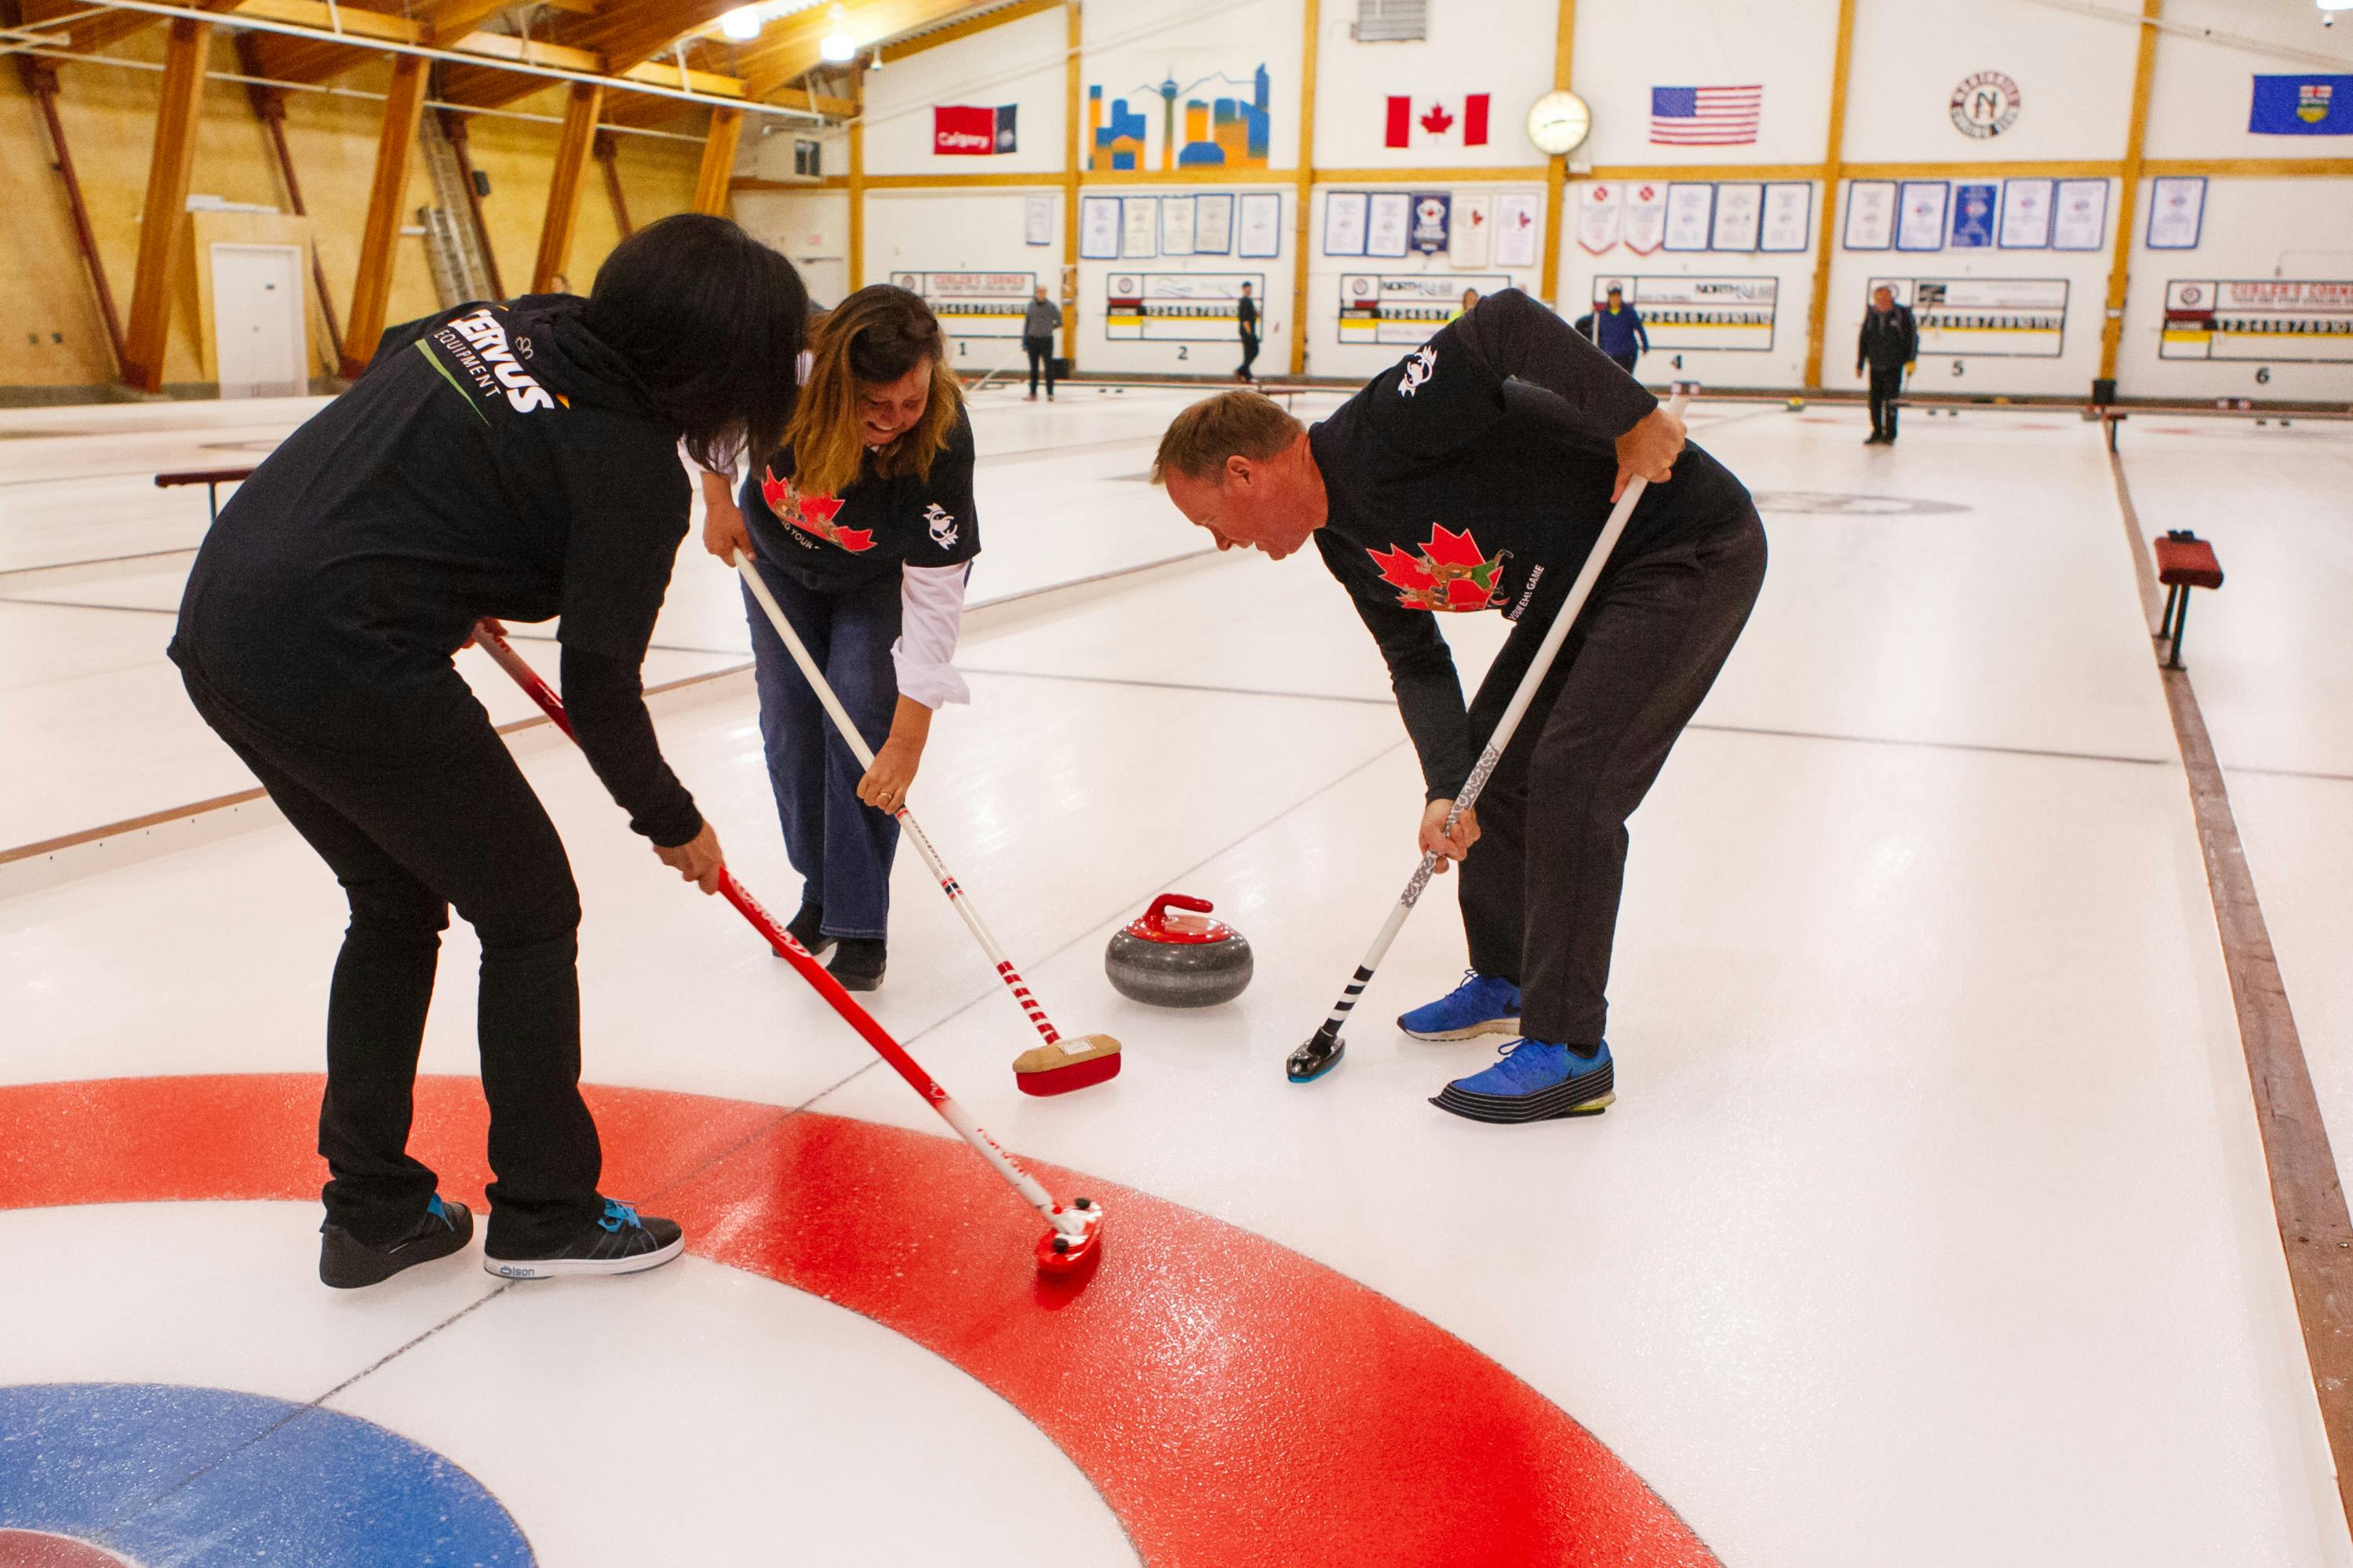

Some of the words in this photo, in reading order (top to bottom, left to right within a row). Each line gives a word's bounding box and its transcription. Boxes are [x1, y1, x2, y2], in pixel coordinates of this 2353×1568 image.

[938, 131, 990, 150] Calgary
[959, 341, 966, 355] 1
[1178, 346, 1188, 360] 2
[434, 329, 501, 398] EQUIPMENT
[1671, 355, 1682, 369] 4
[1952, 360, 1965, 377] 5
[2255, 366, 2270, 384] 6
[791, 529, 813, 549] YOUR
[1526, 565, 1544, 590] GAME
[500, 1265, 535, 1276] Olson
